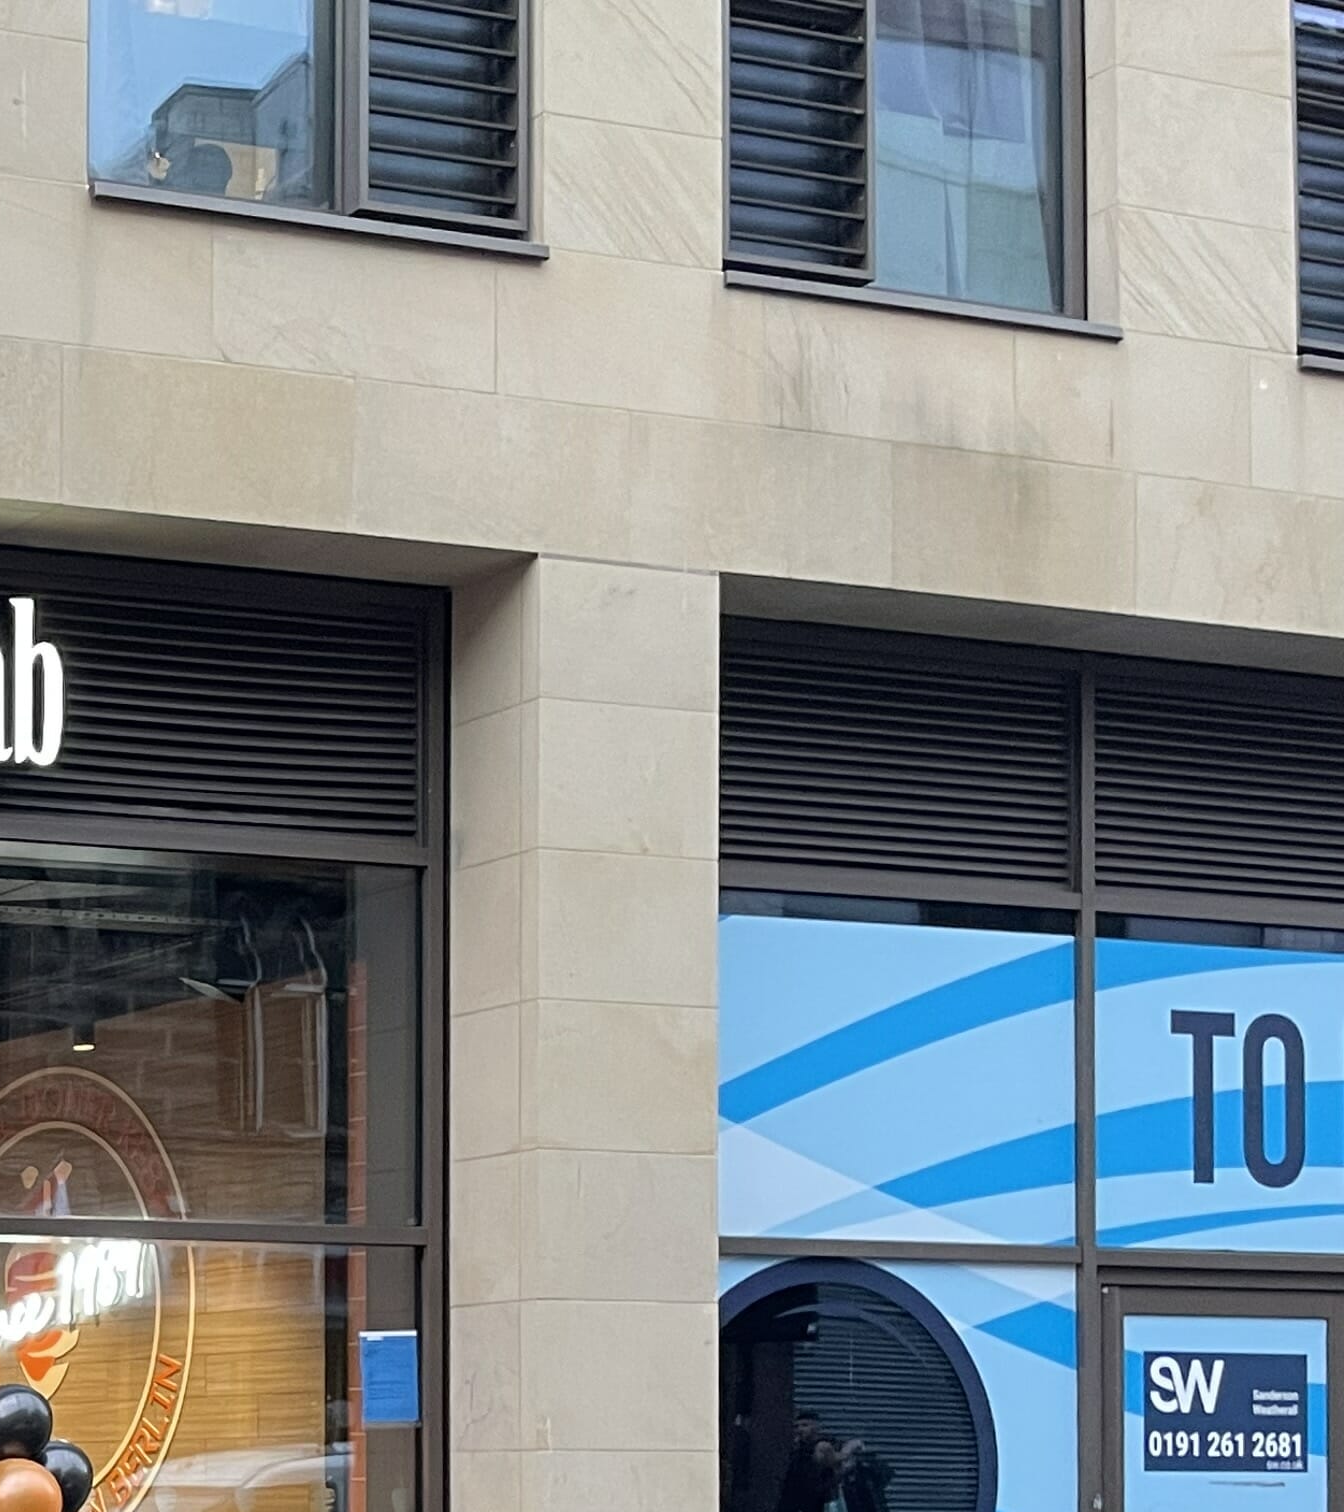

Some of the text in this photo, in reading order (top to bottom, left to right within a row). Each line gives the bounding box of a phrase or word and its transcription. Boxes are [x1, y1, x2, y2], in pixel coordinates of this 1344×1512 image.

[1170, 1009, 1306, 1188] TO
[110, 1353, 184, 1509] BERLIN
[1149, 1355, 1225, 1415] SW
[1148, 1431, 1302, 1457] 0191 261 2681
